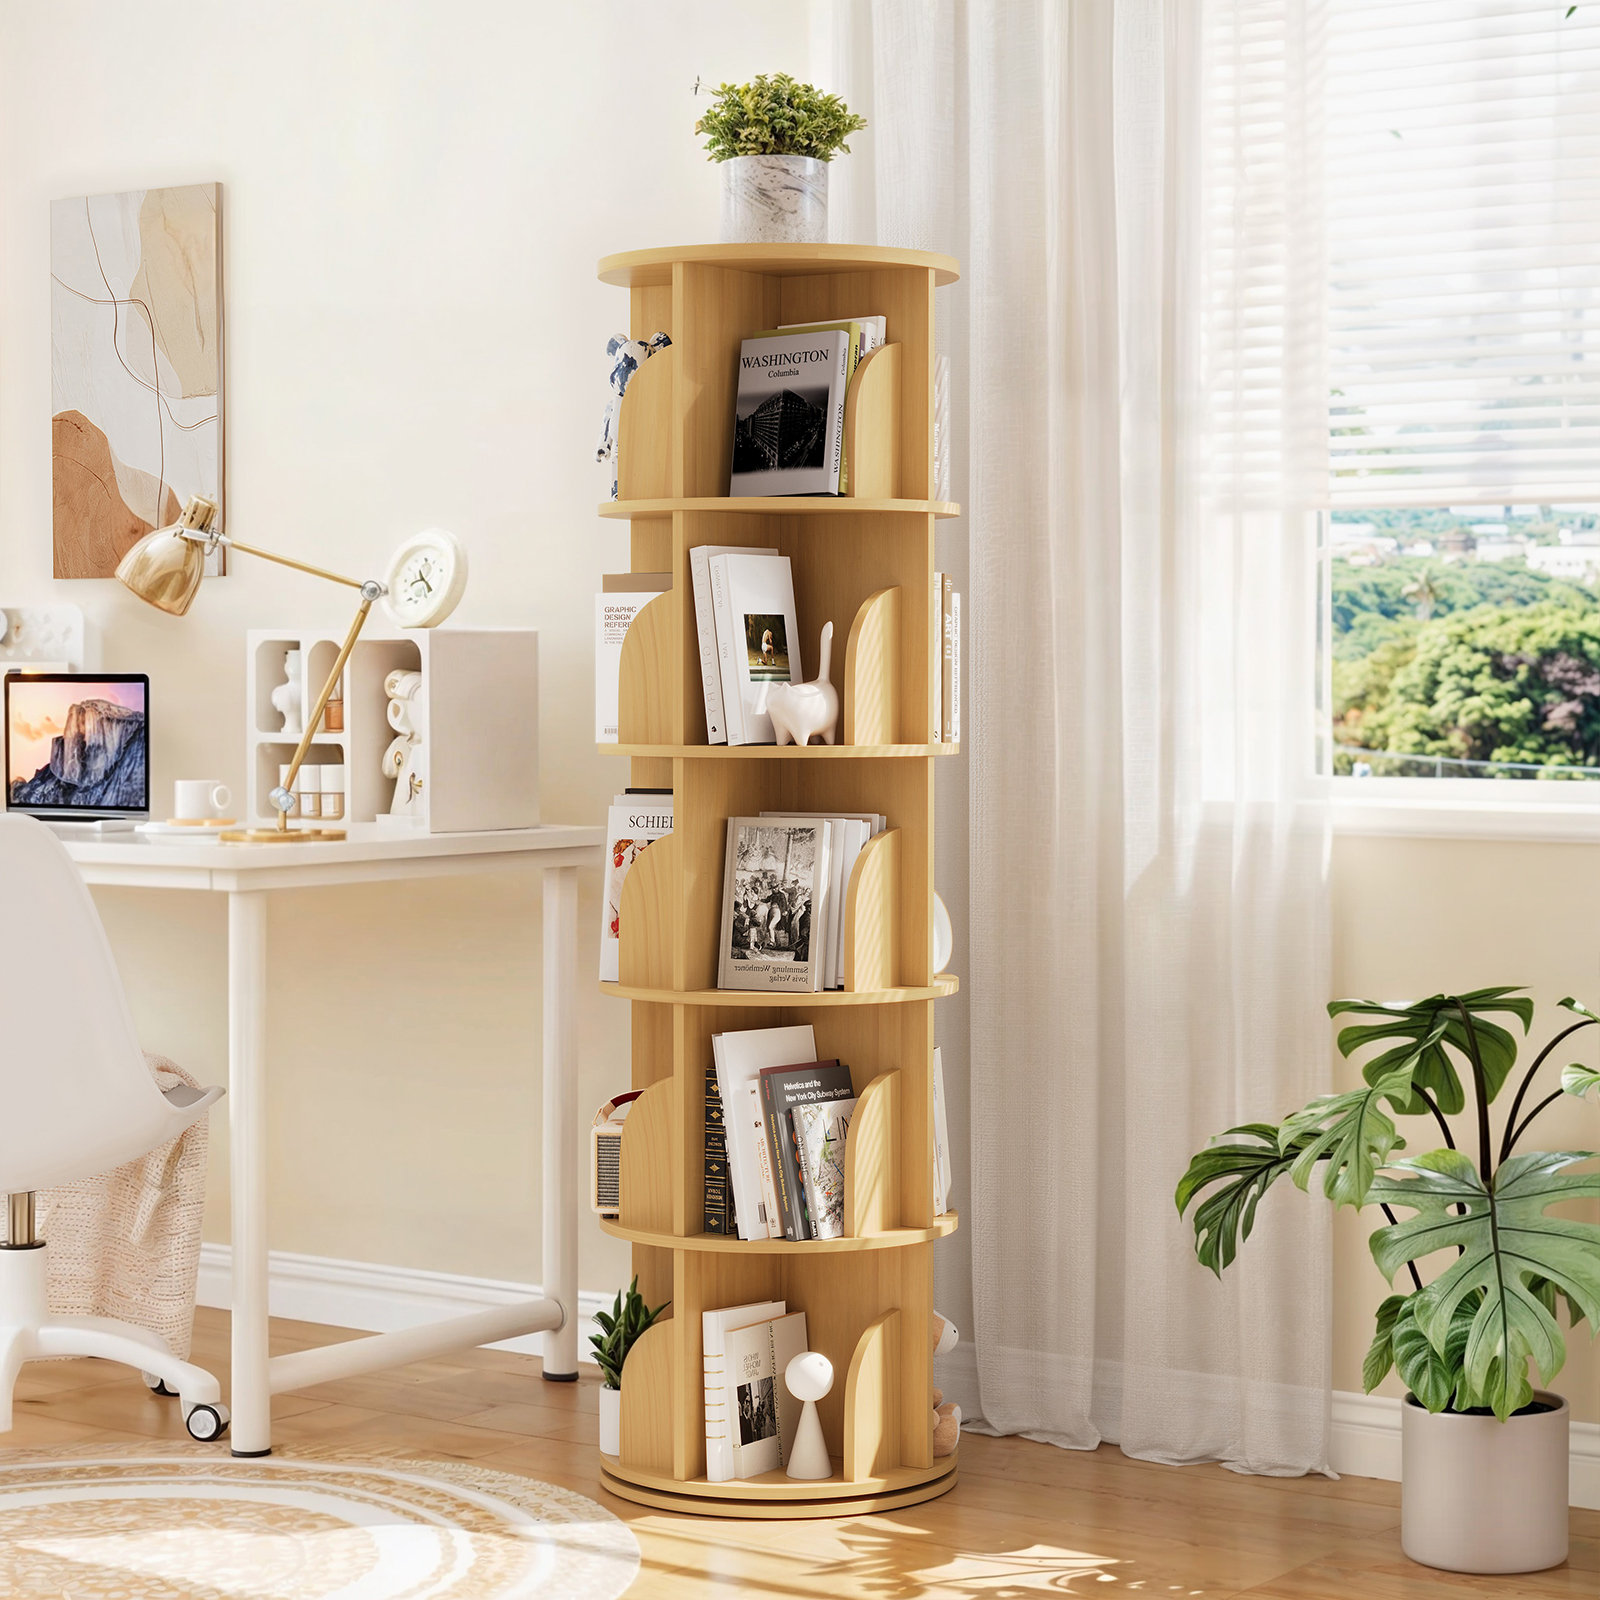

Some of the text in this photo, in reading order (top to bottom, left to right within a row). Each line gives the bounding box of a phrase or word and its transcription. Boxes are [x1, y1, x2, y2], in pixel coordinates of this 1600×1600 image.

[742, 349, 829, 369] WASHINGTON
[768, 368, 800, 378] Columbia
[833, 403, 844, 473] WASHINGTON
[783, 1082, 805, 1091] Helvetica
[785, 1088, 851, 1103] New York City Subway System
